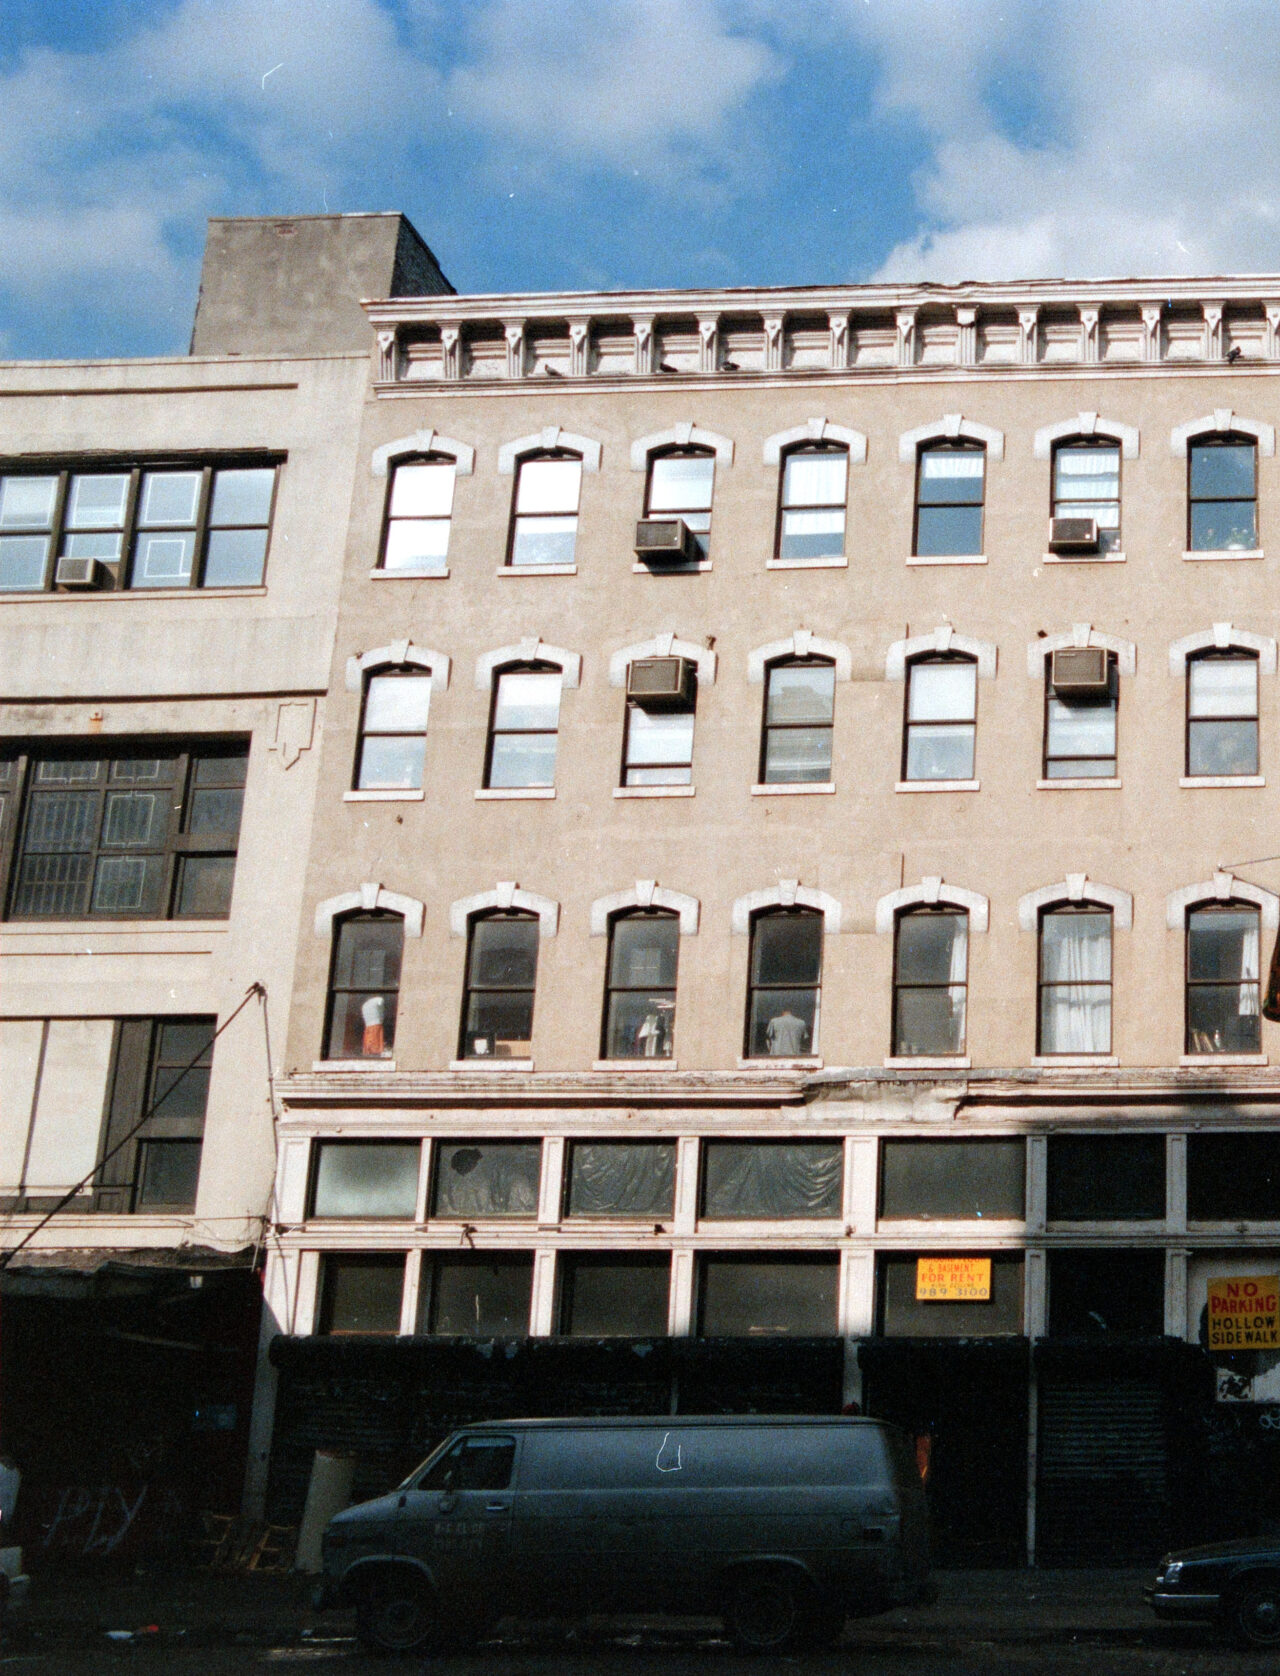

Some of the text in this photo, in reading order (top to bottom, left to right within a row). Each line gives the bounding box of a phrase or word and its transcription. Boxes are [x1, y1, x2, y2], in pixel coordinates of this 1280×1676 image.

[938, 1263, 974, 1273] BASEMENT
[921, 1273, 984, 1283] FOR RENT
[919, 1287, 988, 1297] 989 3100
[1226, 1282, 1258, 1298] NO
[1211, 1294, 1277, 1314] PARKING
[1212, 1316, 1276, 1331] HOLLOW
